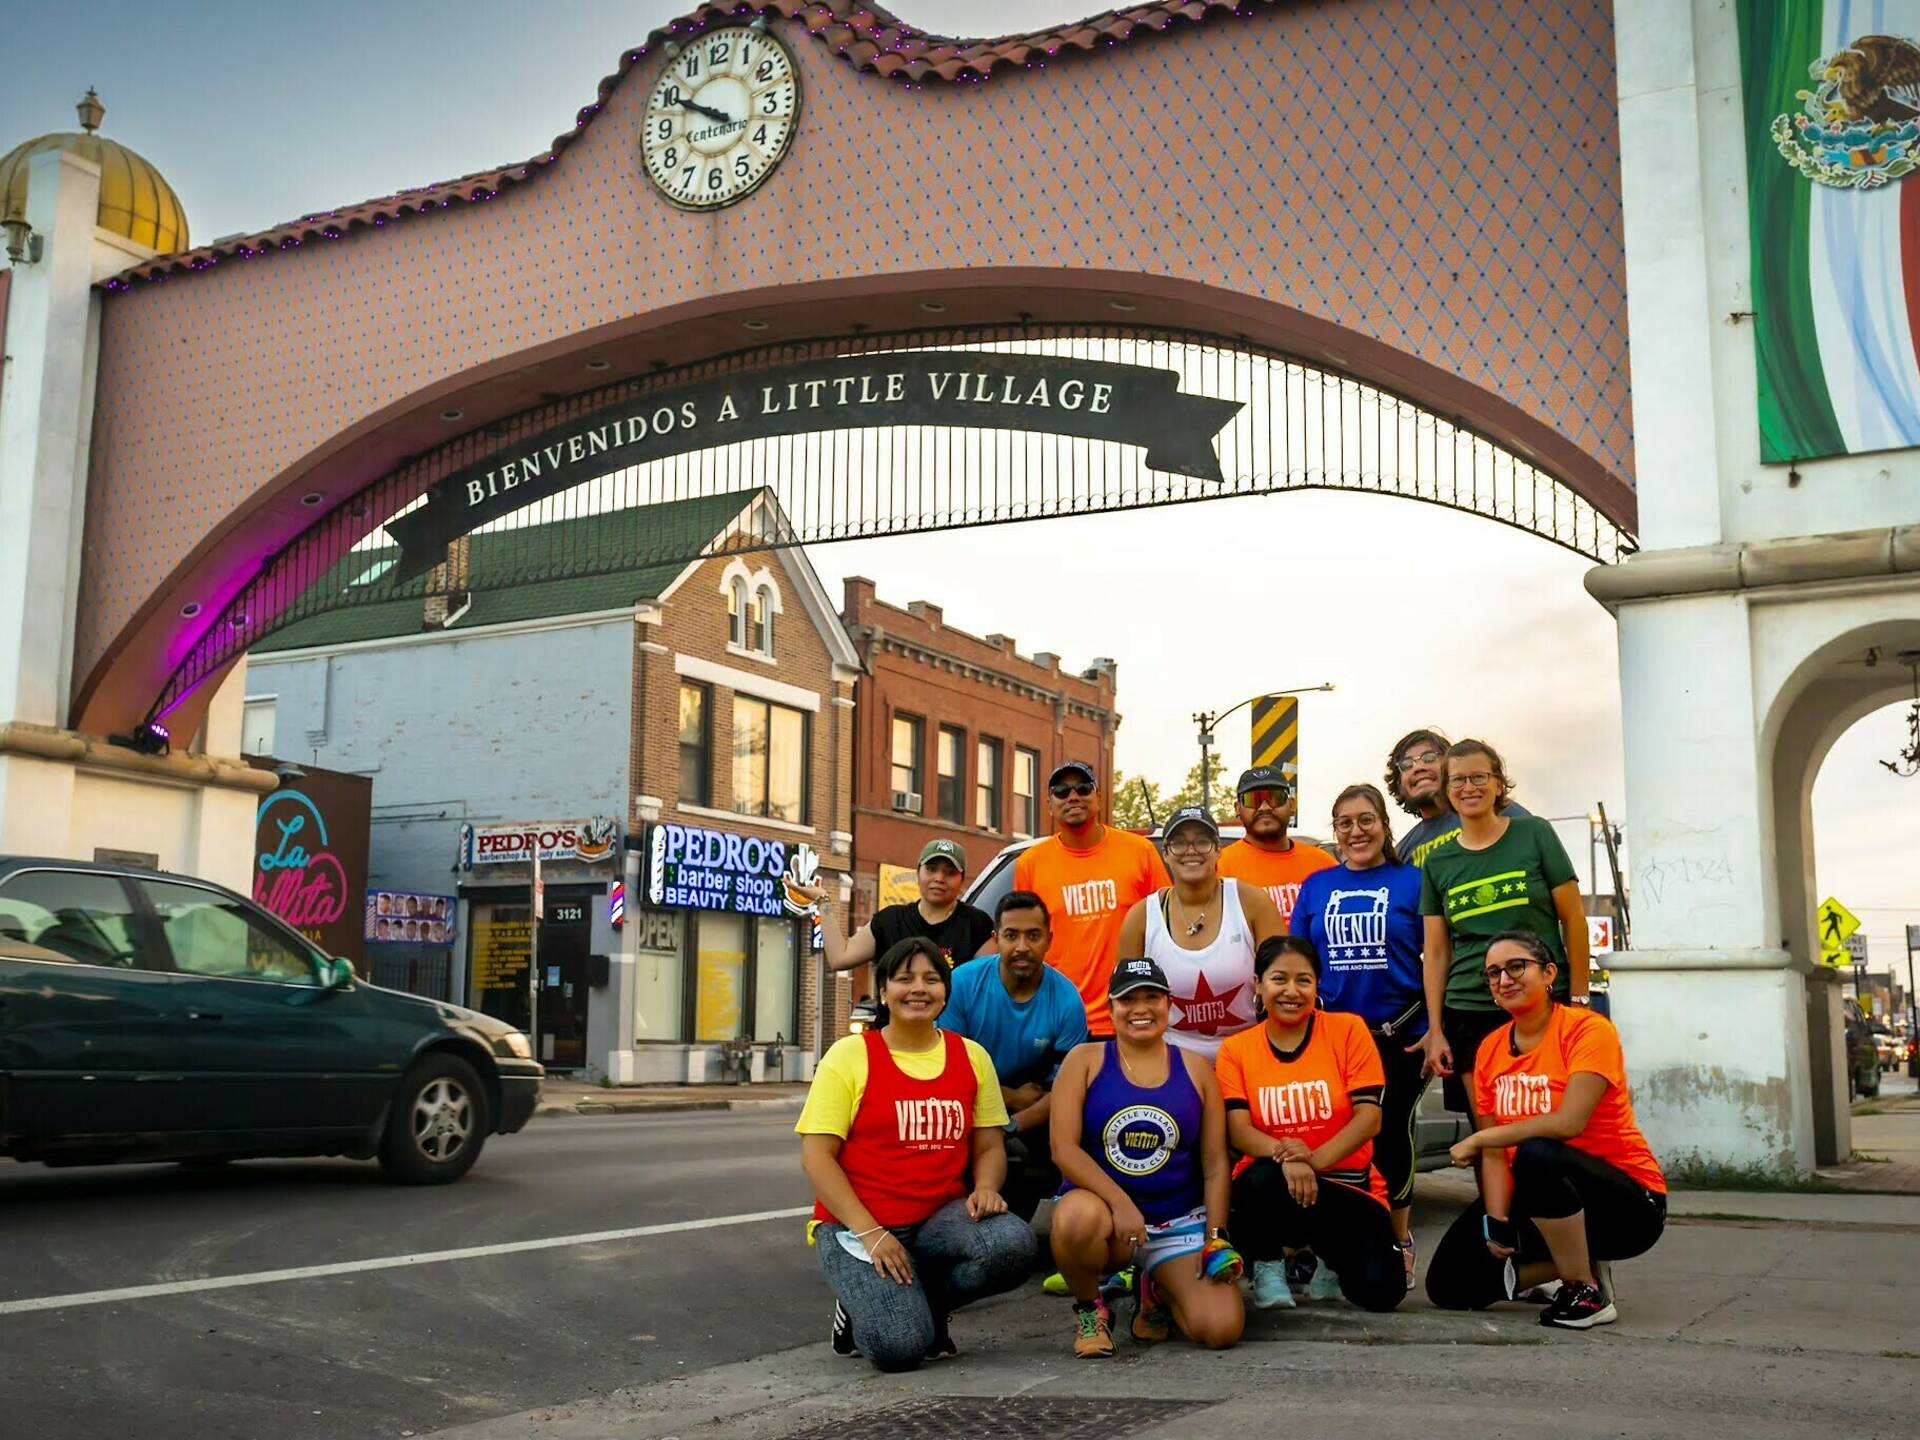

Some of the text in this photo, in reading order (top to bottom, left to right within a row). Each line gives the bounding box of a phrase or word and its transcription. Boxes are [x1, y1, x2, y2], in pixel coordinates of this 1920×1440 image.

[709, 43, 729, 66] 12
[742, 44, 750, 65] 1
[686, 56, 699, 78] 11
[756, 60, 774, 83] 2
[662, 85, 680, 108] 10
[763, 91, 777, 114] 3
[658, 118, 673, 140] 9
[687, 119, 748, 144] Centenario
[752, 123, 767, 146] 4
[664, 147, 677, 169] 8
[735, 154, 750, 177] 5
[682, 165, 697, 189] 7
[708, 167, 723, 190] 6
[466, 372, 1114, 507] BIENVENIDOS A LITTLE VILLAGE
[259, 814, 310, 871] La
[477, 830, 576, 853] PEDRO'S
[665, 824, 786, 878] PEDRO'S
[479, 851, 519, 862] barbershop
[677, 864, 774, 898] barber shop
[665, 887, 782, 916] BEAUTY SALON
[1062, 879, 1117, 916] VIENTO
[556, 908, 582, 919] 3121
[1324, 912, 1386, 947] VIENTO
[1185, 1001, 1225, 1023] VIENTO
[1258, 1079, 1333, 1126] VIENTO
[895, 1097, 965, 1141] VIENTO
[1111, 1111, 1174, 1138] LITTLE VILLAGE
[1125, 1132, 1159, 1149] VIENTO
[1149, 1146, 1167, 1166] CLU
